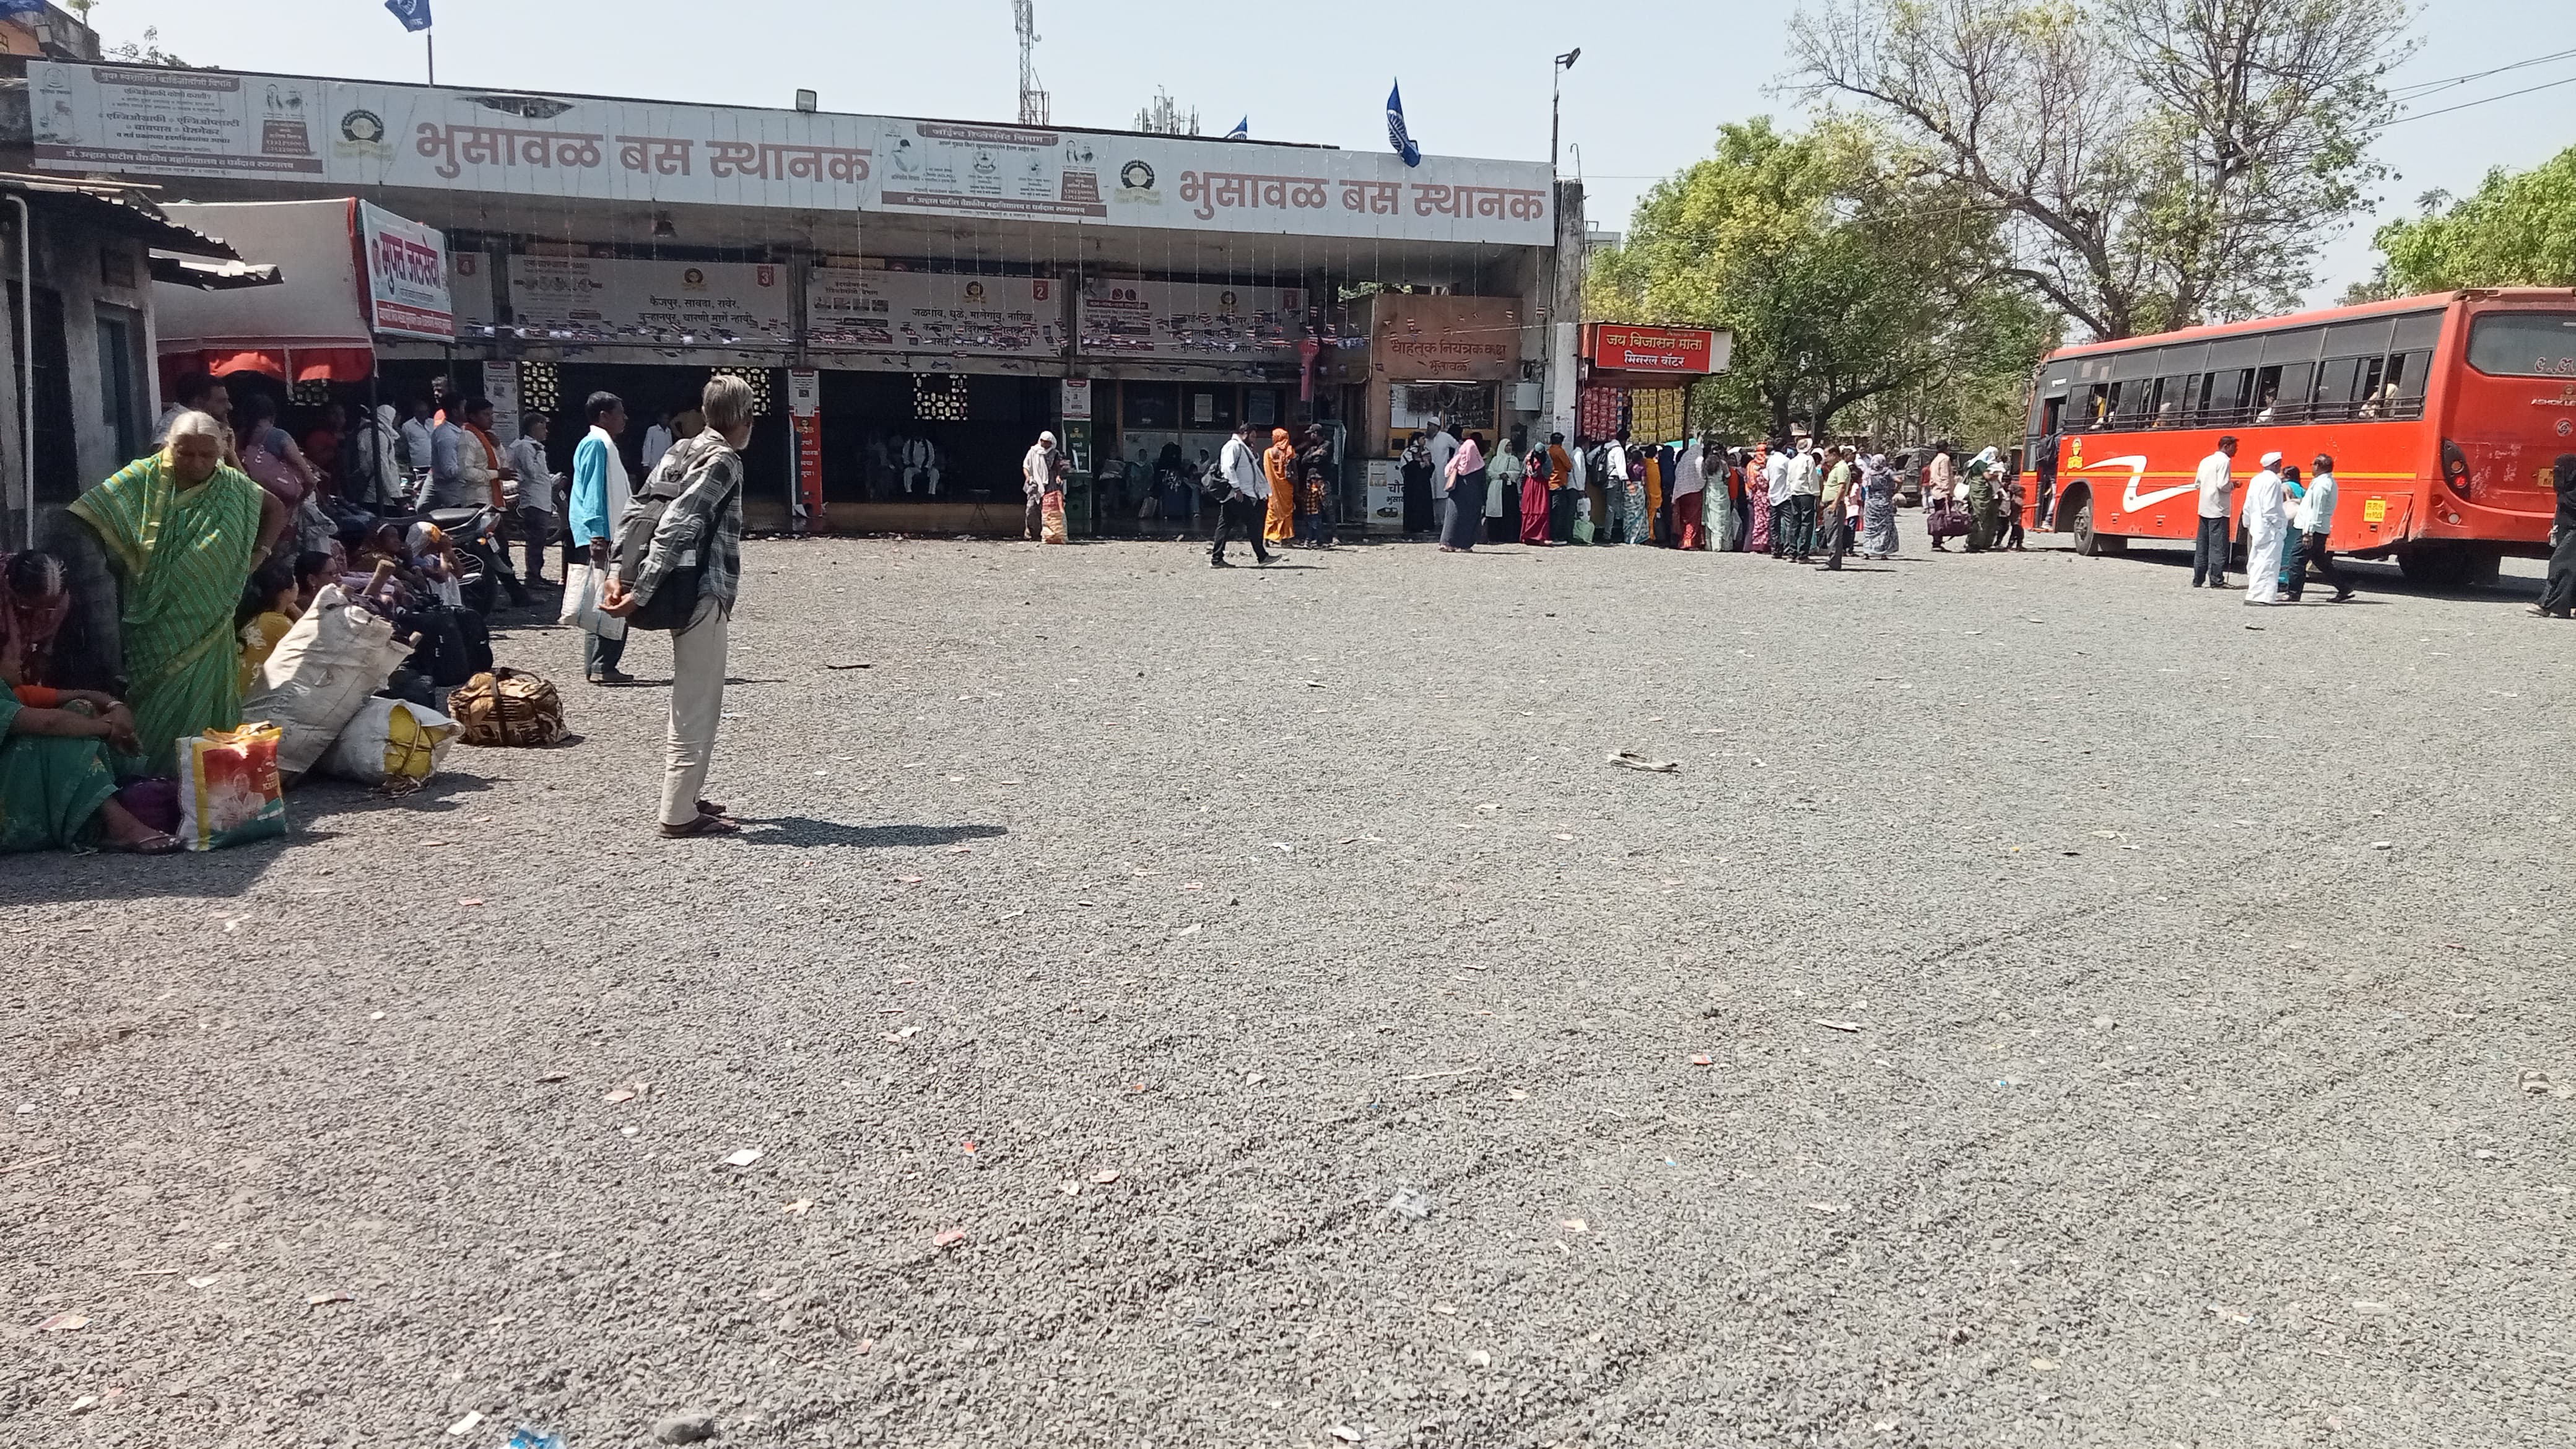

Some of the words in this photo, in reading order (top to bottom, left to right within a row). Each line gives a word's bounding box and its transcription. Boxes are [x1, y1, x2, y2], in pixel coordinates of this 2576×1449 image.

[416, 121, 604, 180] भुसावळ
[616, 135, 694, 176] बस
[705, 139, 872, 185] स्थानक
[1180, 169, 1329, 220] भुसावळ
[1339, 179, 1401, 215] बस
[1411, 183, 1546, 222] स्थानक
[461, 261, 470, 272] 4
[762, 272, 769, 284] 3
[1036, 287, 1044, 298] 2
[949, 308, 967, 321] धुळे,
[1439, 339, 1484, 355] नियंत्रक
[1484, 344, 1507, 359] कक्ष
[1606, 334, 1627, 347] जय
[1678, 338, 1703, 351] माता
[1624, 350, 1658, 366] मिनरल
[1661, 352, 1686, 367] वॉटर
